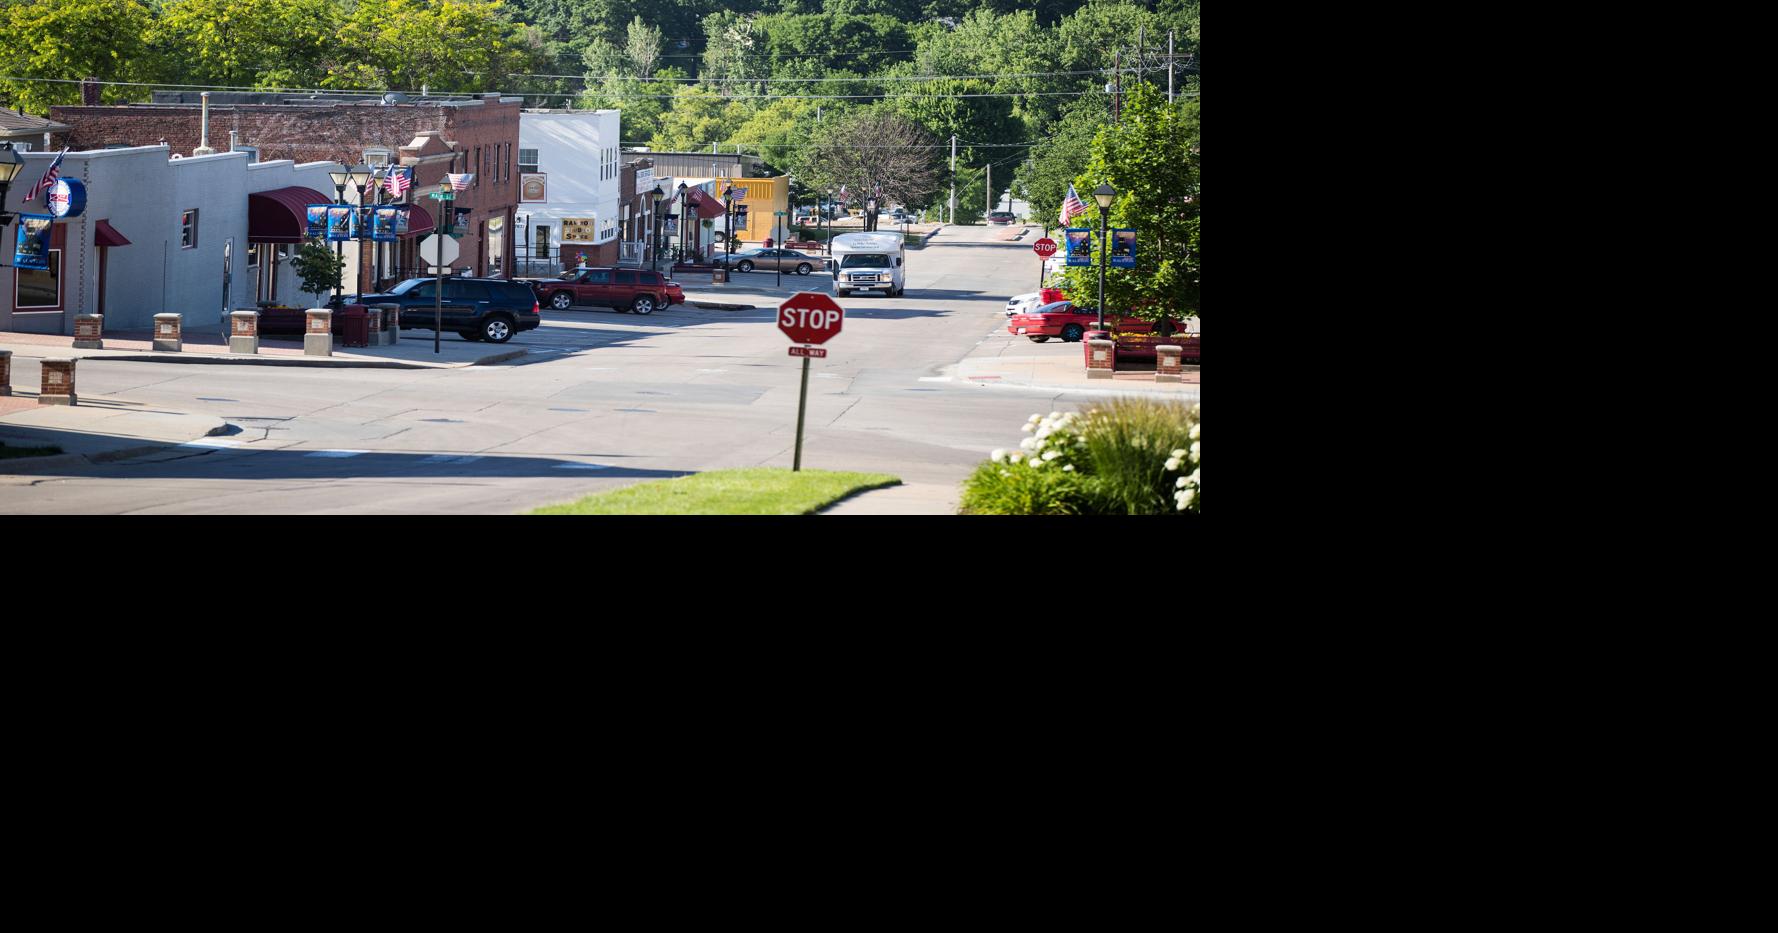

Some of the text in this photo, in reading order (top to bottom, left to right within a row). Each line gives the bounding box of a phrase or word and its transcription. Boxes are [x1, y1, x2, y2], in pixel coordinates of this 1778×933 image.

[1035, 243, 1056, 252] STOP
[782, 308, 840, 330] STOP
[791, 348, 825, 357] ALL WAY
